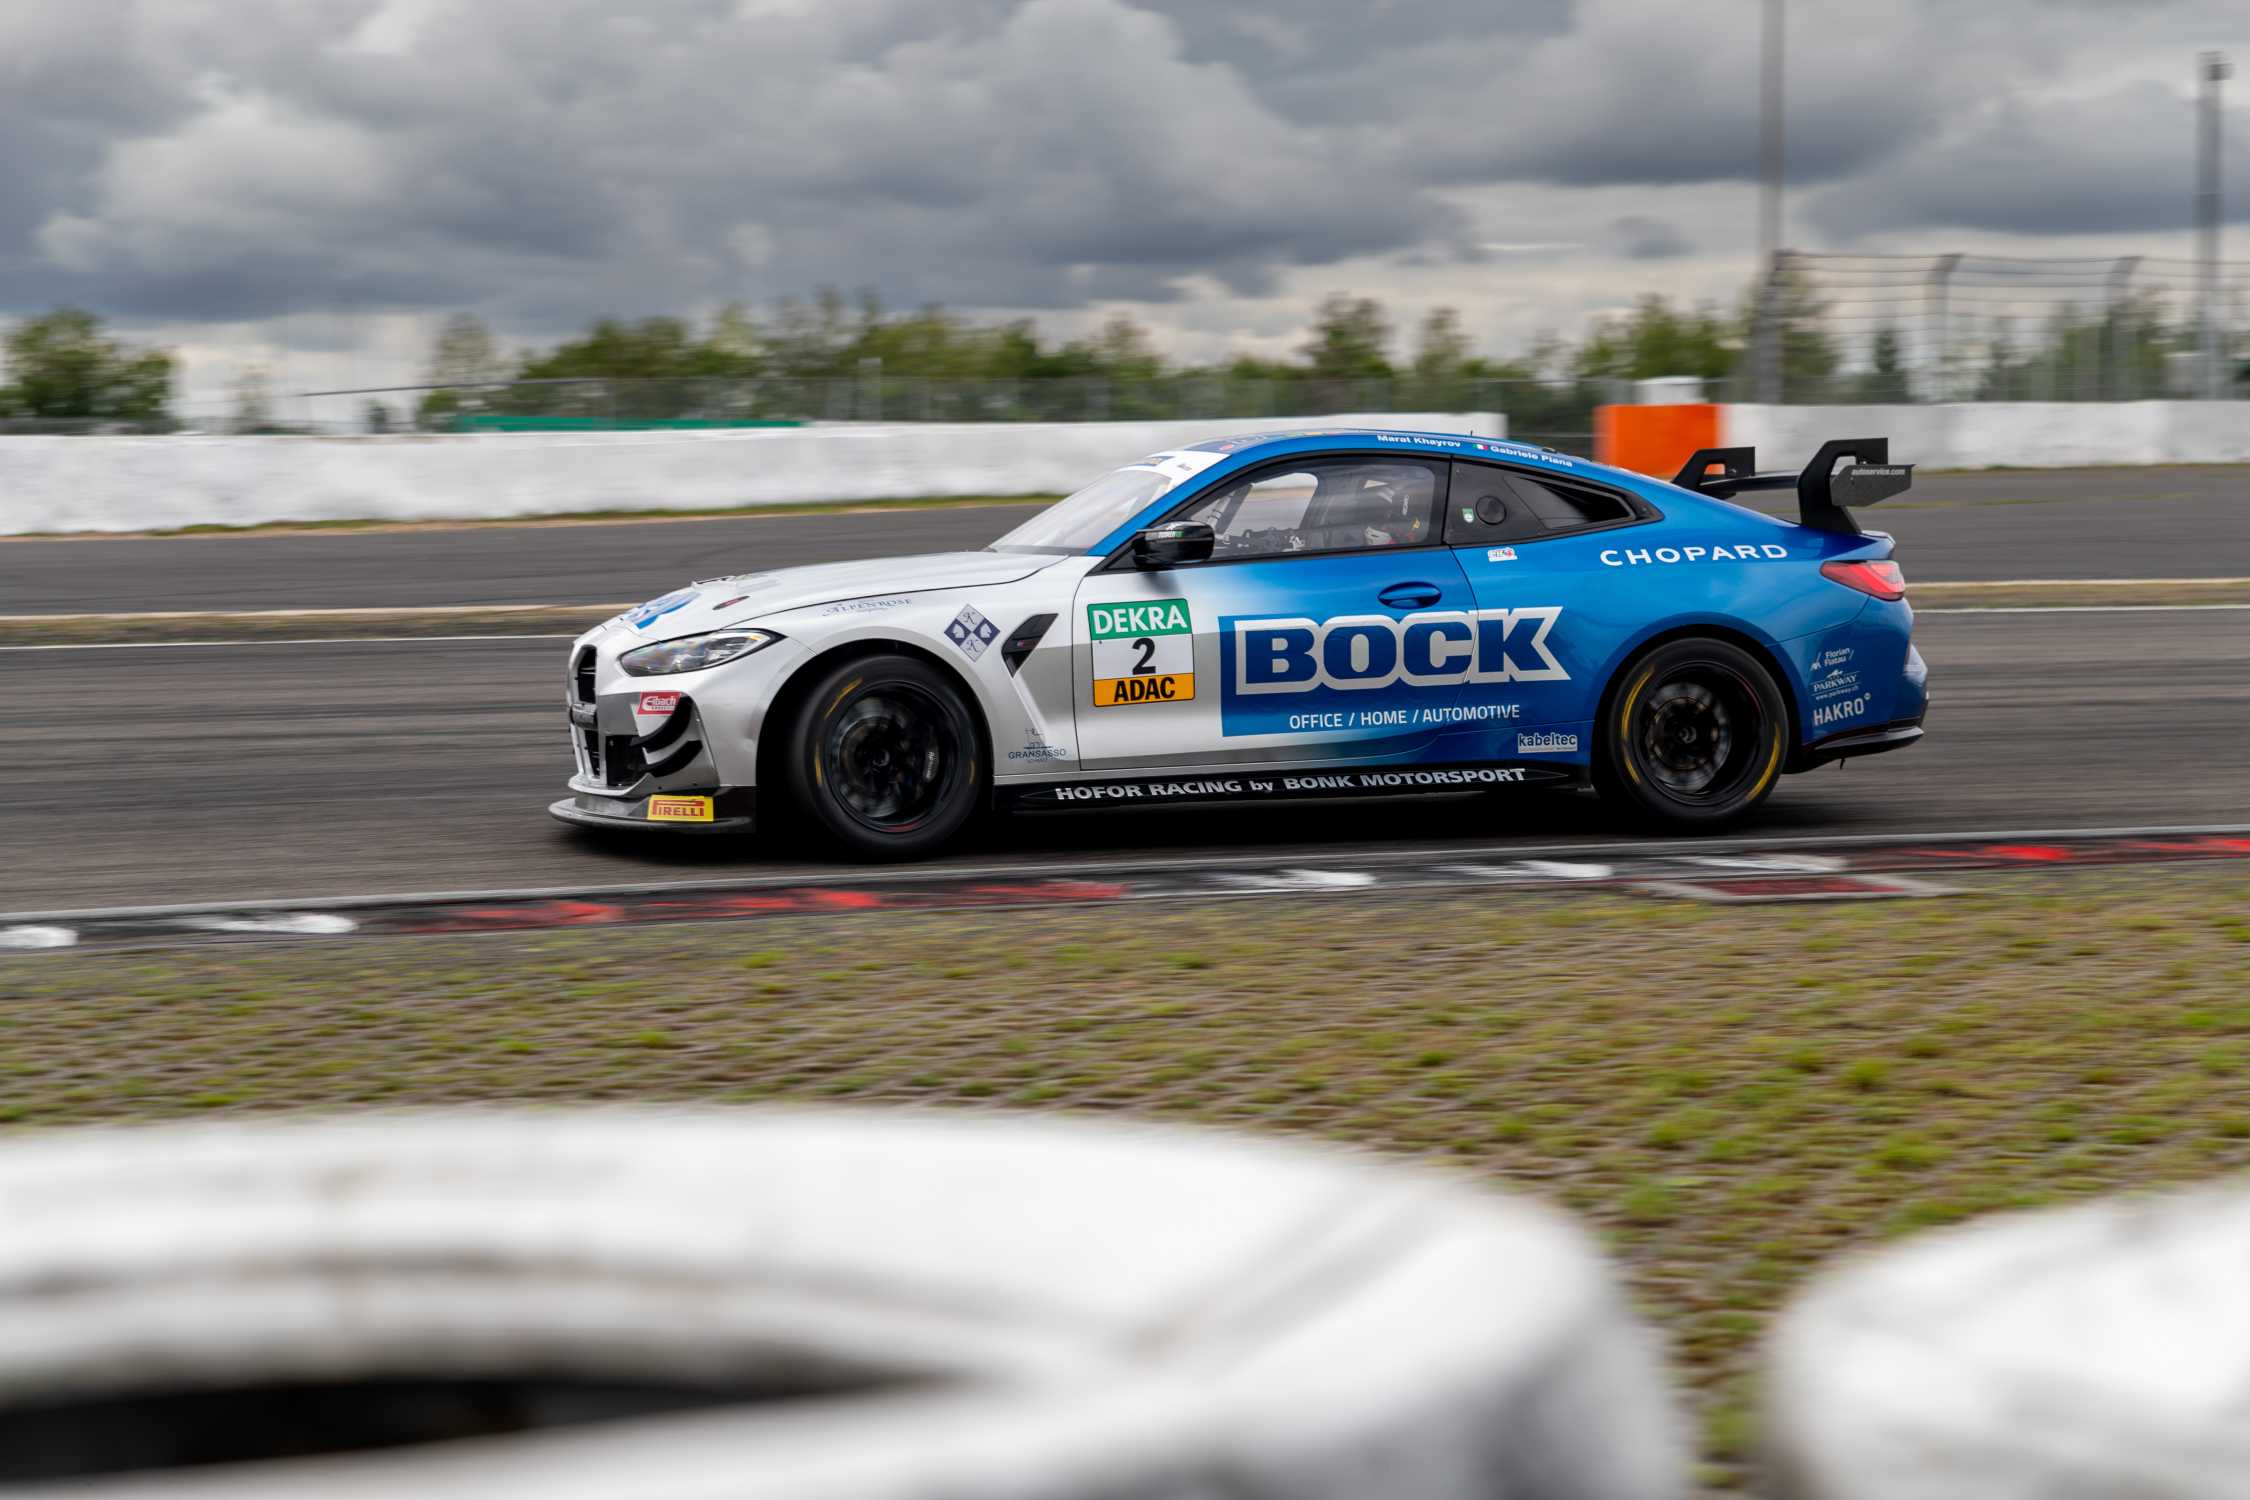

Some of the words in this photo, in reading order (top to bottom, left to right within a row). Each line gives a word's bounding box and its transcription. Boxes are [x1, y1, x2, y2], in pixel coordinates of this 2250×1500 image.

[1376, 434, 1411, 444] Marat
[1414, 437, 1461, 448] Khayrov
[1490, 446, 1539, 460] Gabriele
[1541, 454, 1573, 468] Piana
[1600, 544, 1788, 567] CHOPARD
[1093, 605, 1188, 634] DEKRA
[1132, 637, 1156, 675] 2
[1234, 606, 1571, 695] BOCK
[1113, 677, 1175, 703] ADAC
[1813, 674, 1857, 692] PARKWAY
[1289, 713, 1343, 729] OFFICE
[1361, 710, 1407, 725] HOME
[1422, 704, 1520, 723] AUTOMOTIVE
[1813, 698, 1864, 726] HAKRO
[1519, 733, 1576, 746] kabeltec
[1008, 749, 1067, 760] GRANSASSO
[1055, 785, 1143, 800] HOFOR
[1148, 780, 1242, 796] RACING
[1249, 780, 1273, 792] by
[1283, 775, 1354, 790] BONK
[1360, 768, 1526, 787] MOTORSPORT
[652, 799, 705, 816] PIRELLI
